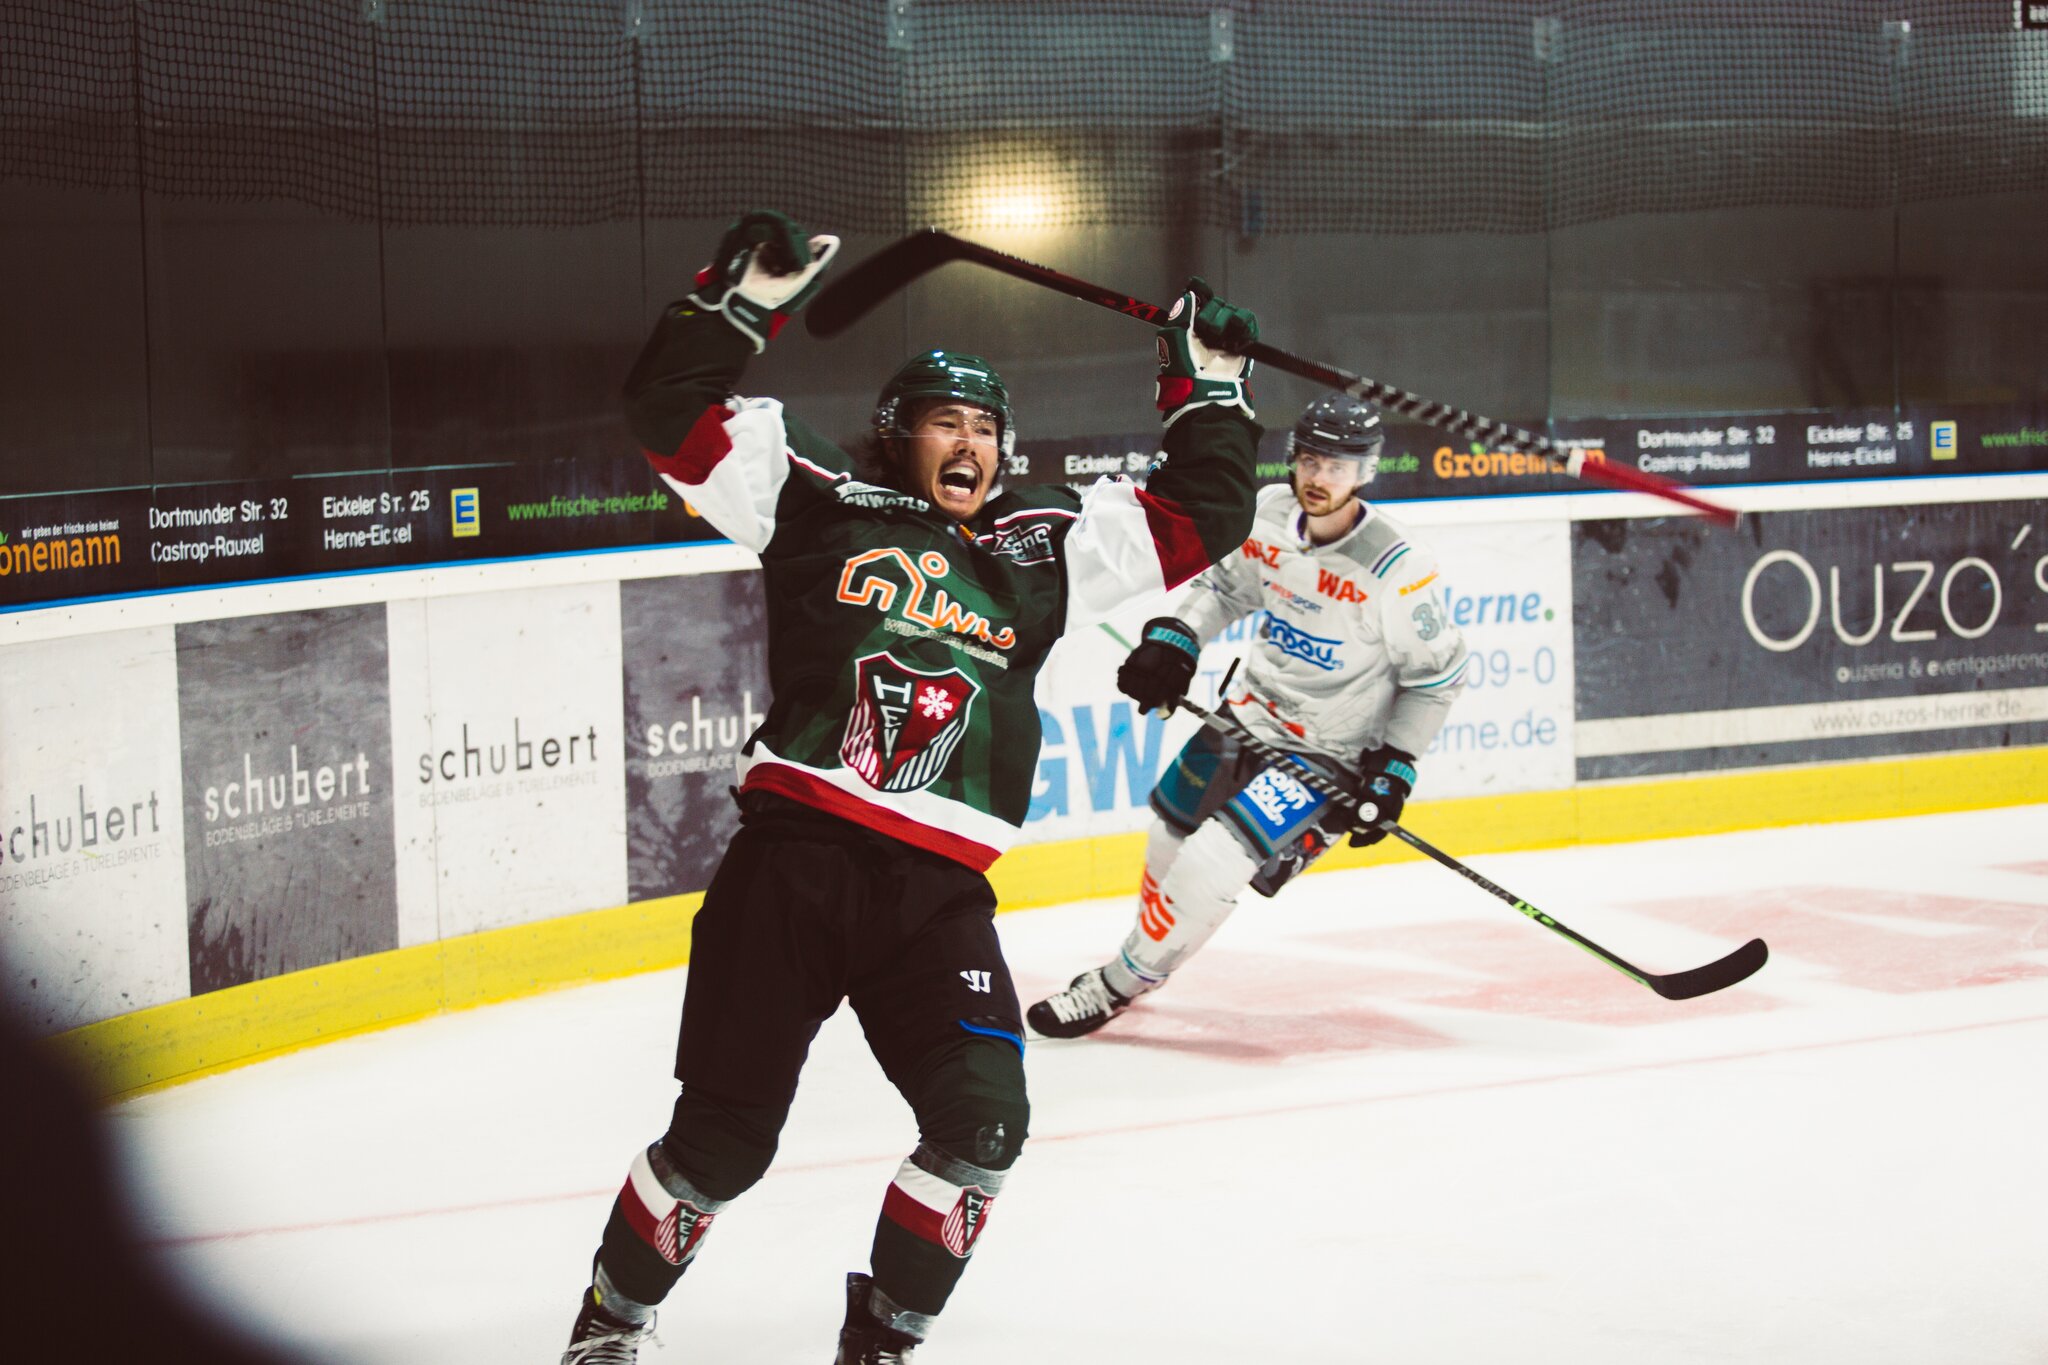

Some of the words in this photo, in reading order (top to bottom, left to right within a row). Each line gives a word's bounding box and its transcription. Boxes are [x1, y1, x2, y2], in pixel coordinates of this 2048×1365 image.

[1756, 425, 1776, 445] 32
[1008, 455, 1030, 476] 32
[149, 502, 236, 530] Dortmunder
[241, 500, 266, 522] Str.
[270, 497, 288, 520] 32
[323, 495, 377, 518] Eickeler
[410, 490, 431, 512] 25
[455, 494, 475, 524] E
[507, 488, 669, 521] www.frische-revier.de
[151, 532, 264, 564] Castrop-Rauxel
[1444, 586, 1555, 627] erne.
[872, 674, 913, 760] HEV
[1811, 696, 2023, 733] www.ouzos-herne.de
[418, 717, 597, 784] schubert
[204, 744, 371, 822] schubert
[0, 784, 160, 866] chubert
